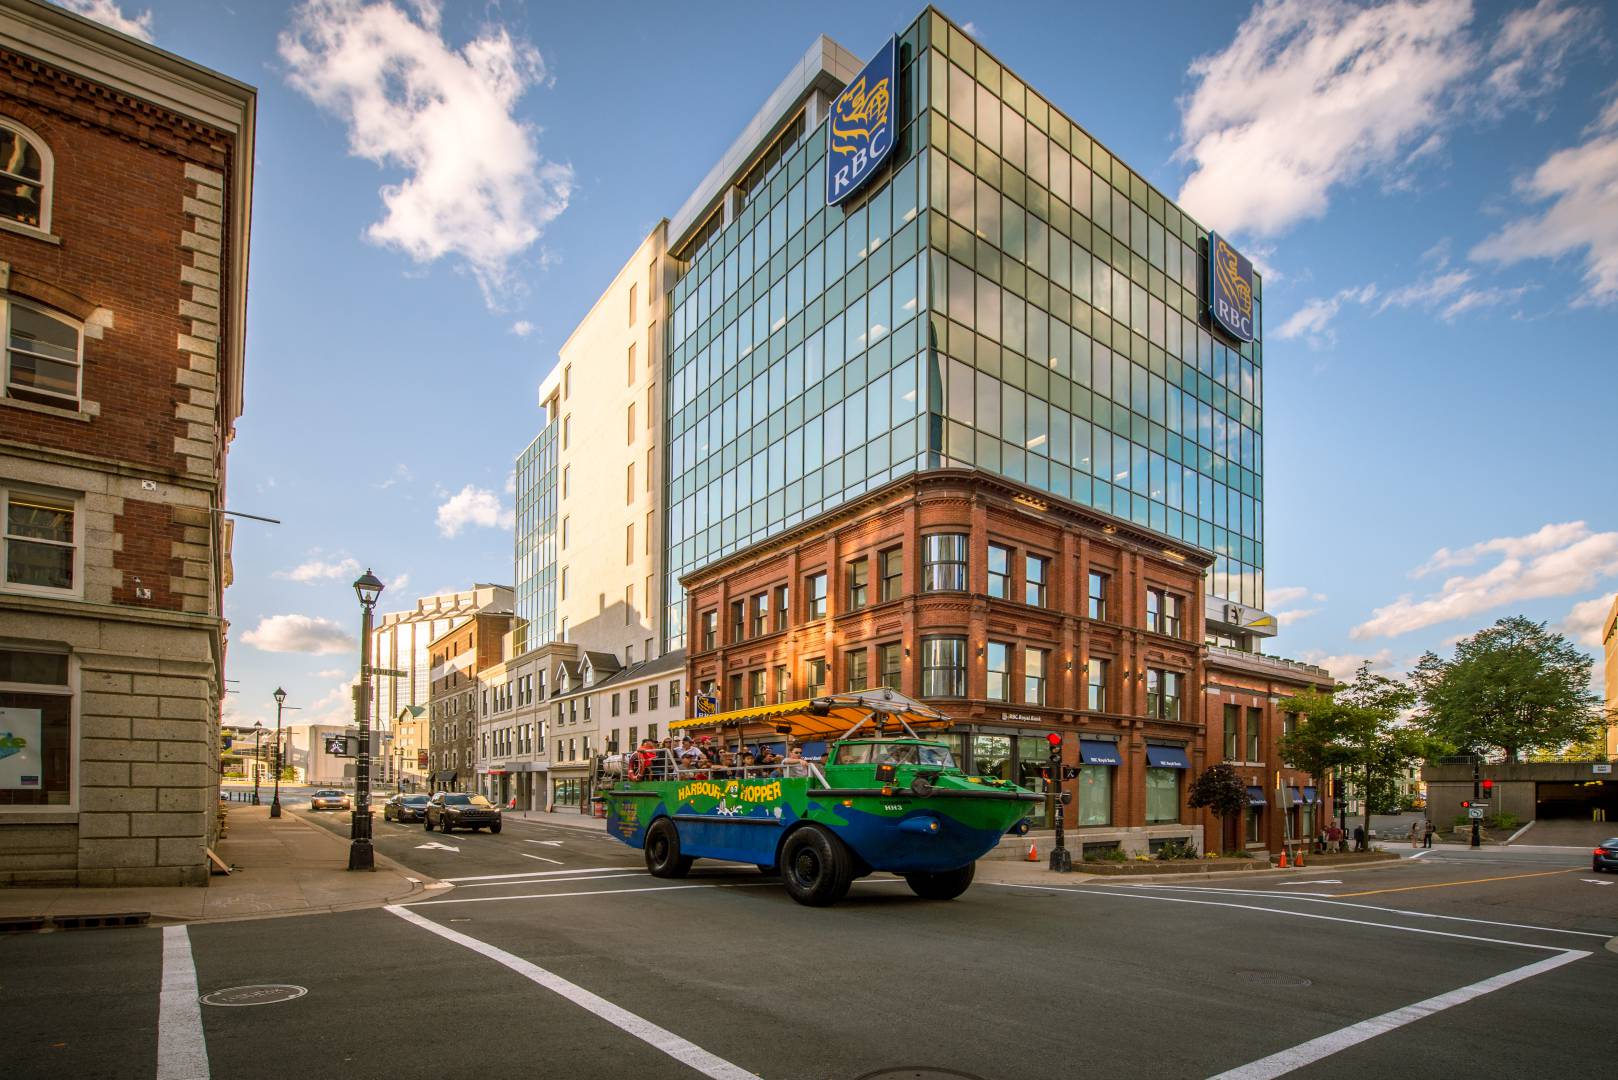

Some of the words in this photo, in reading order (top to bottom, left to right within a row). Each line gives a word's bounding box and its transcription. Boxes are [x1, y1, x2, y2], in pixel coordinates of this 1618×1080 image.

[834, 127, 886, 195] RBC
[1219, 298, 1250, 336] RBC
[678, 782, 721, 800] HARBOUR
[740, 781, 782, 802] HOPPER
